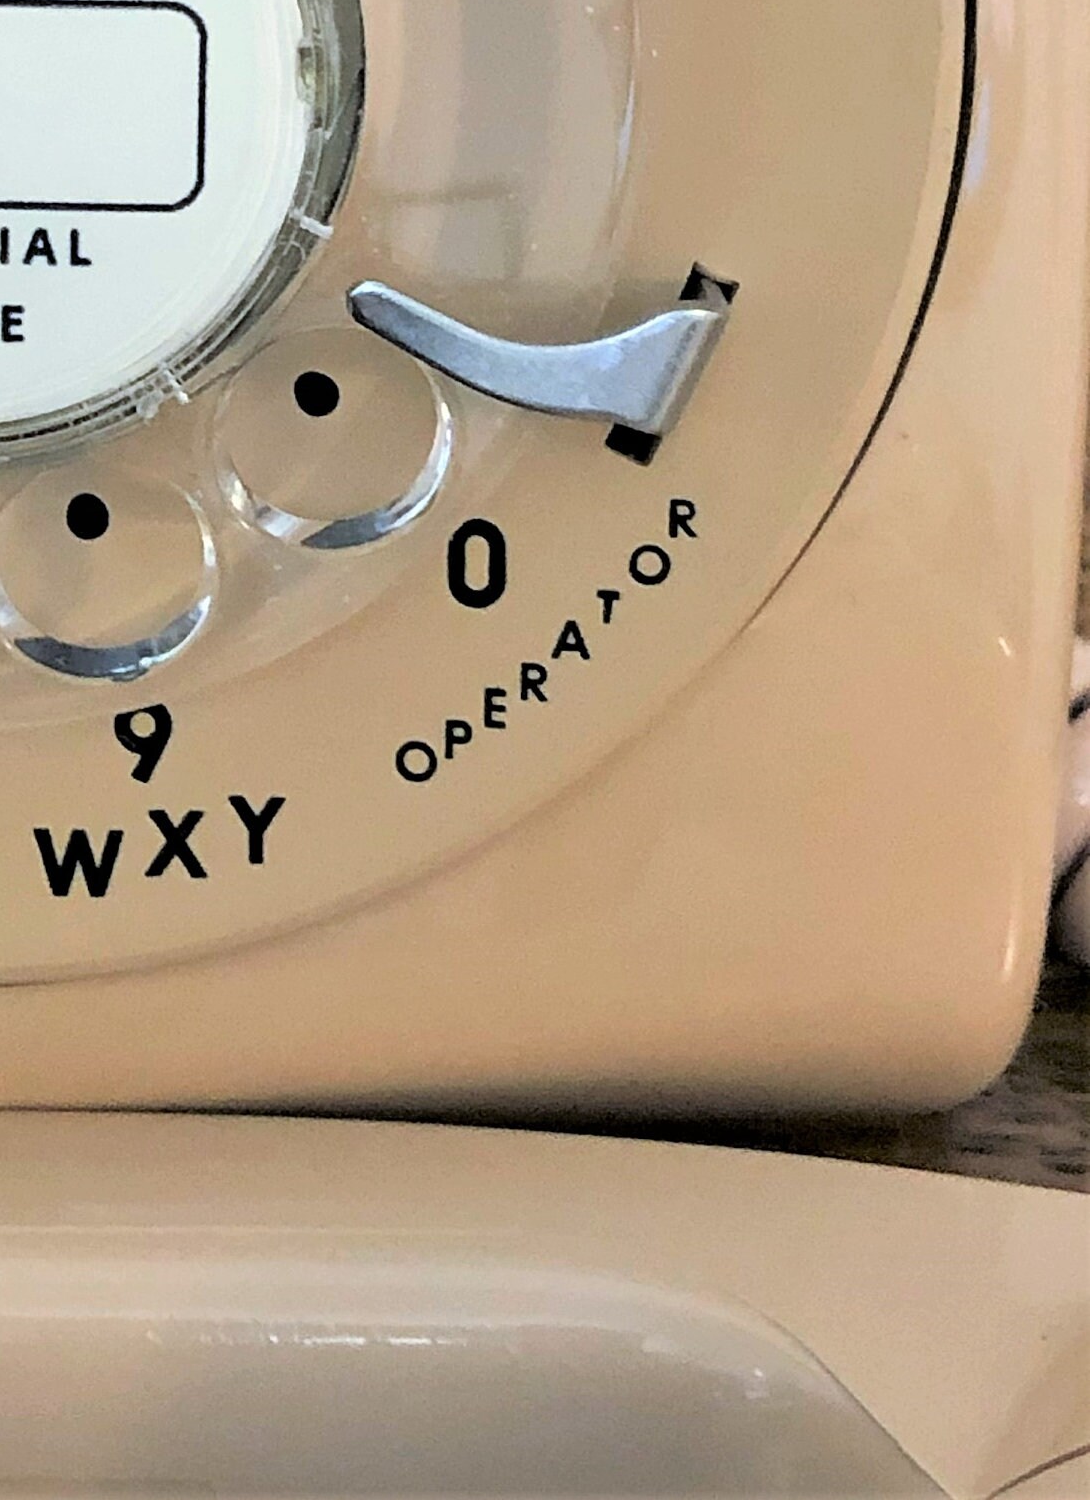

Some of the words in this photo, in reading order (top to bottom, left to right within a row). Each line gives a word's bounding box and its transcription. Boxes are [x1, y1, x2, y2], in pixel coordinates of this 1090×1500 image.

[446, 517, 508, 610] 0
[394, 497, 700, 784] OPERATOR
[112, 702, 174, 785] 9
